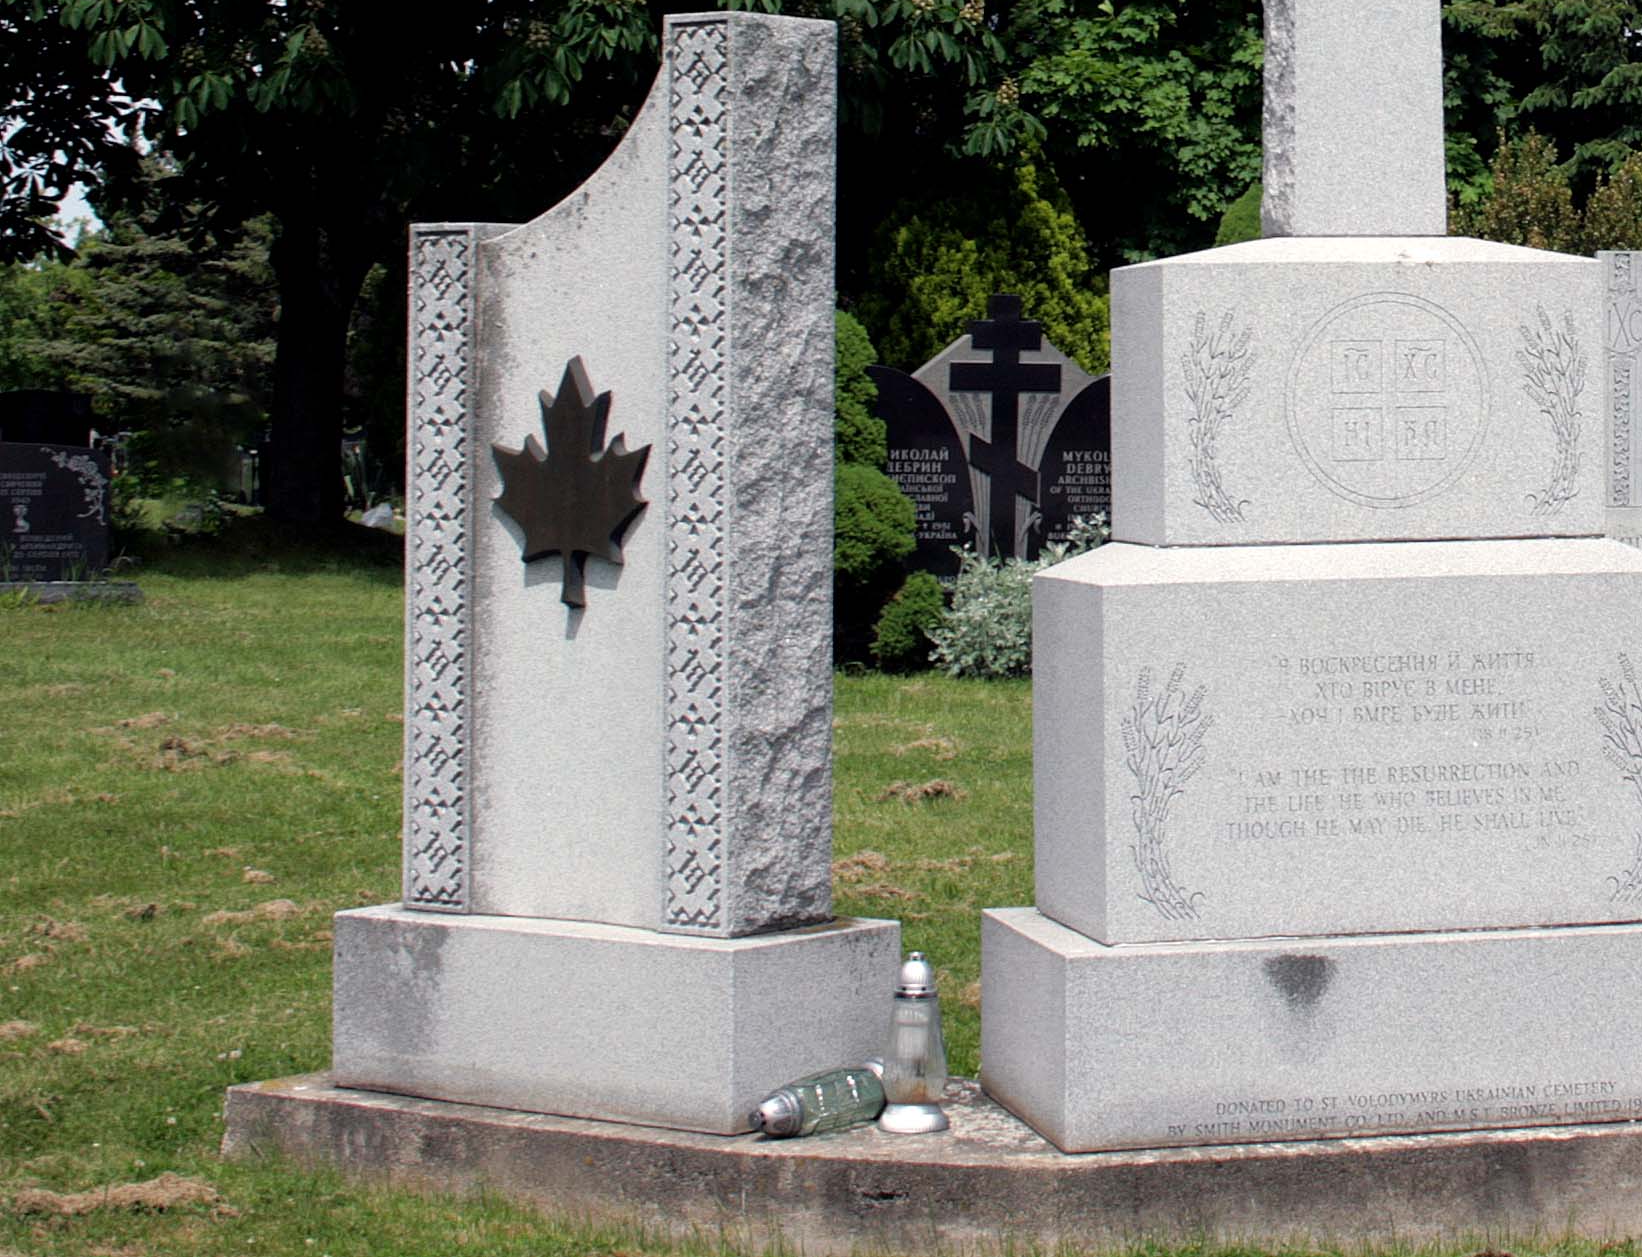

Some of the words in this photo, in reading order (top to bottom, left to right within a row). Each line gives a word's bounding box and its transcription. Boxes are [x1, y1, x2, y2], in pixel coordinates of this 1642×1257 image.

[890, 446, 949, 461] ИКОЛАЙ
[1063, 450, 1110, 463] MYKOL
[1066, 463, 1110, 474] DEBRY
[1067, 495, 1111, 504] ORTHODO
[1087, 486, 1111, 494] UKRA
[1300, 654, 1438, 675] ВОСКРЕСЕННЯ
[1315, 681, 1353, 700] ХТО
[1425, 679, 1437, 696] В
[1255, 770, 1281, 788] AM
[1292, 768, 1329, 786] THE
[1342, 767, 1377, 785] THE
[1387, 761, 1530, 785] RESURRECTION
[1541, 759, 1580, 778] AND
[1245, 795, 1280, 813] THE
[1340, 792, 1364, 810] HE
[1373, 790, 1416, 809] WHO
[1425, 786, 1505, 808] BELIEVES
[1514, 785, 1531, 803] IN
[1225, 819, 1305, 841] THOUGH
[1316, 818, 1341, 837] HE
[1349, 815, 1387, 835] MAY
[1440, 813, 1466, 832] HE
[1473, 810, 1529, 831] SHALL
[1215, 1099, 1286, 1117] DONATED
[1294, 1098, 1313, 1113] TO
[1455, 1086, 1537, 1103] UKRAINIAN
[1542, 1080, 1618, 1098] CEMETERY
[1167, 1124, 1187, 1138] BY
[1194, 1121, 1241, 1138] SMITH
[1249, 1115, 1337, 1134] MONUMENT
[1416, 1109, 1447, 1125] AND
[1499, 1102, 1556, 1118] BRONZE
[1564, 1098, 1622, 1115] LIMITED
